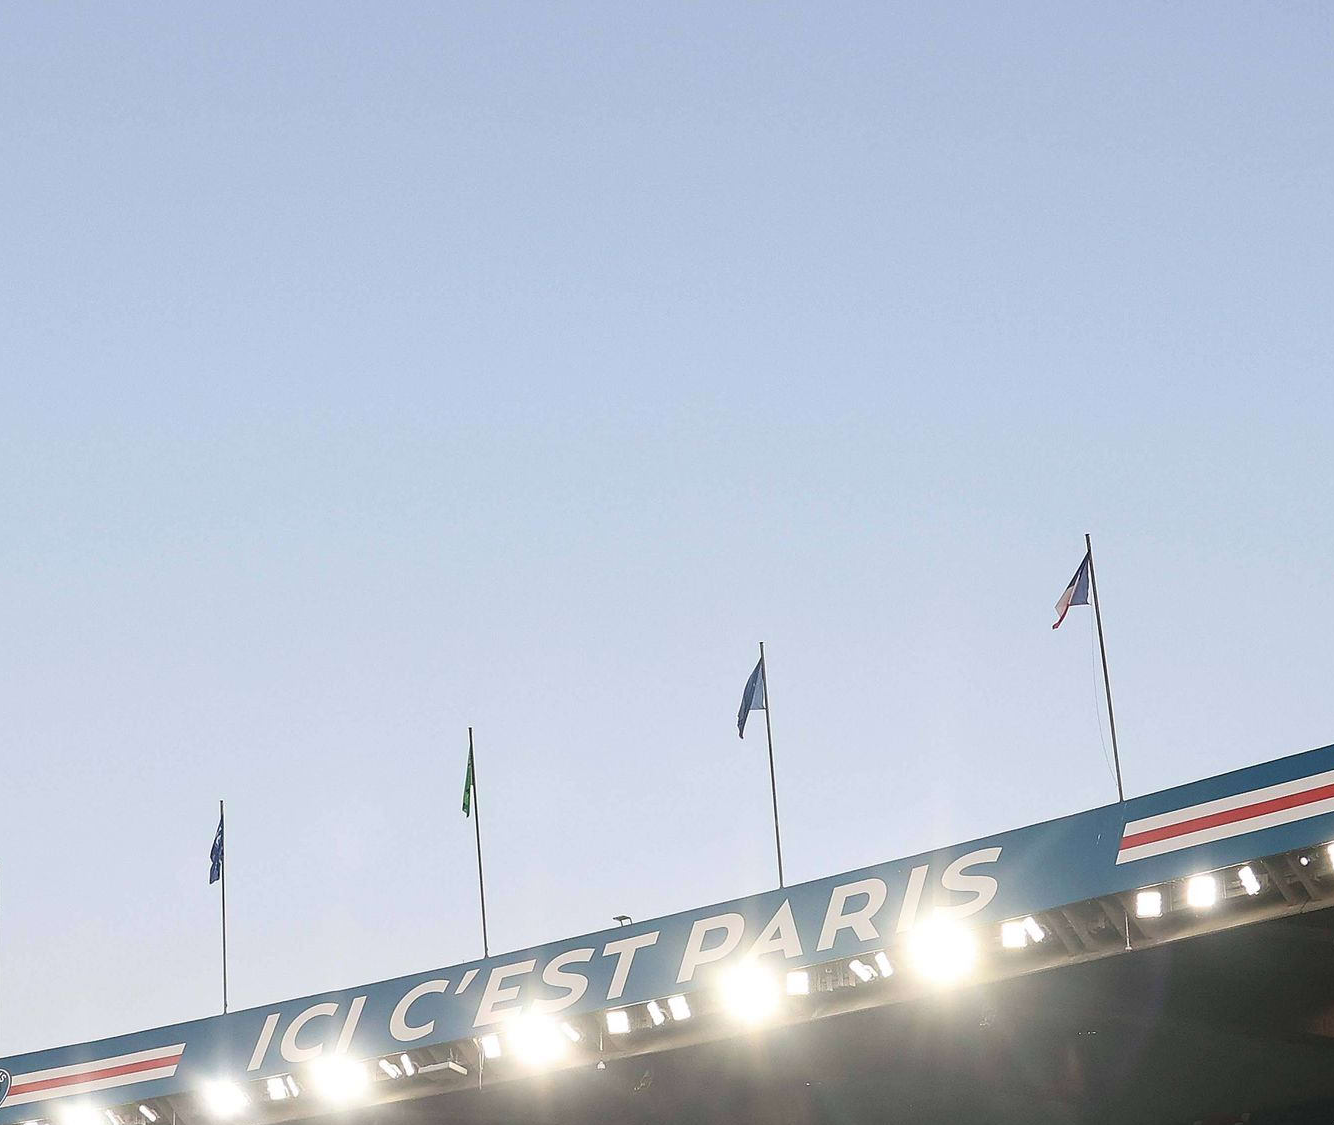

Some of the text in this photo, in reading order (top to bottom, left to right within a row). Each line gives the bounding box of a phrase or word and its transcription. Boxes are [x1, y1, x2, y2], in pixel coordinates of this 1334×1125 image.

[246, 846, 1003, 1072] ICI C'EST PARIS
